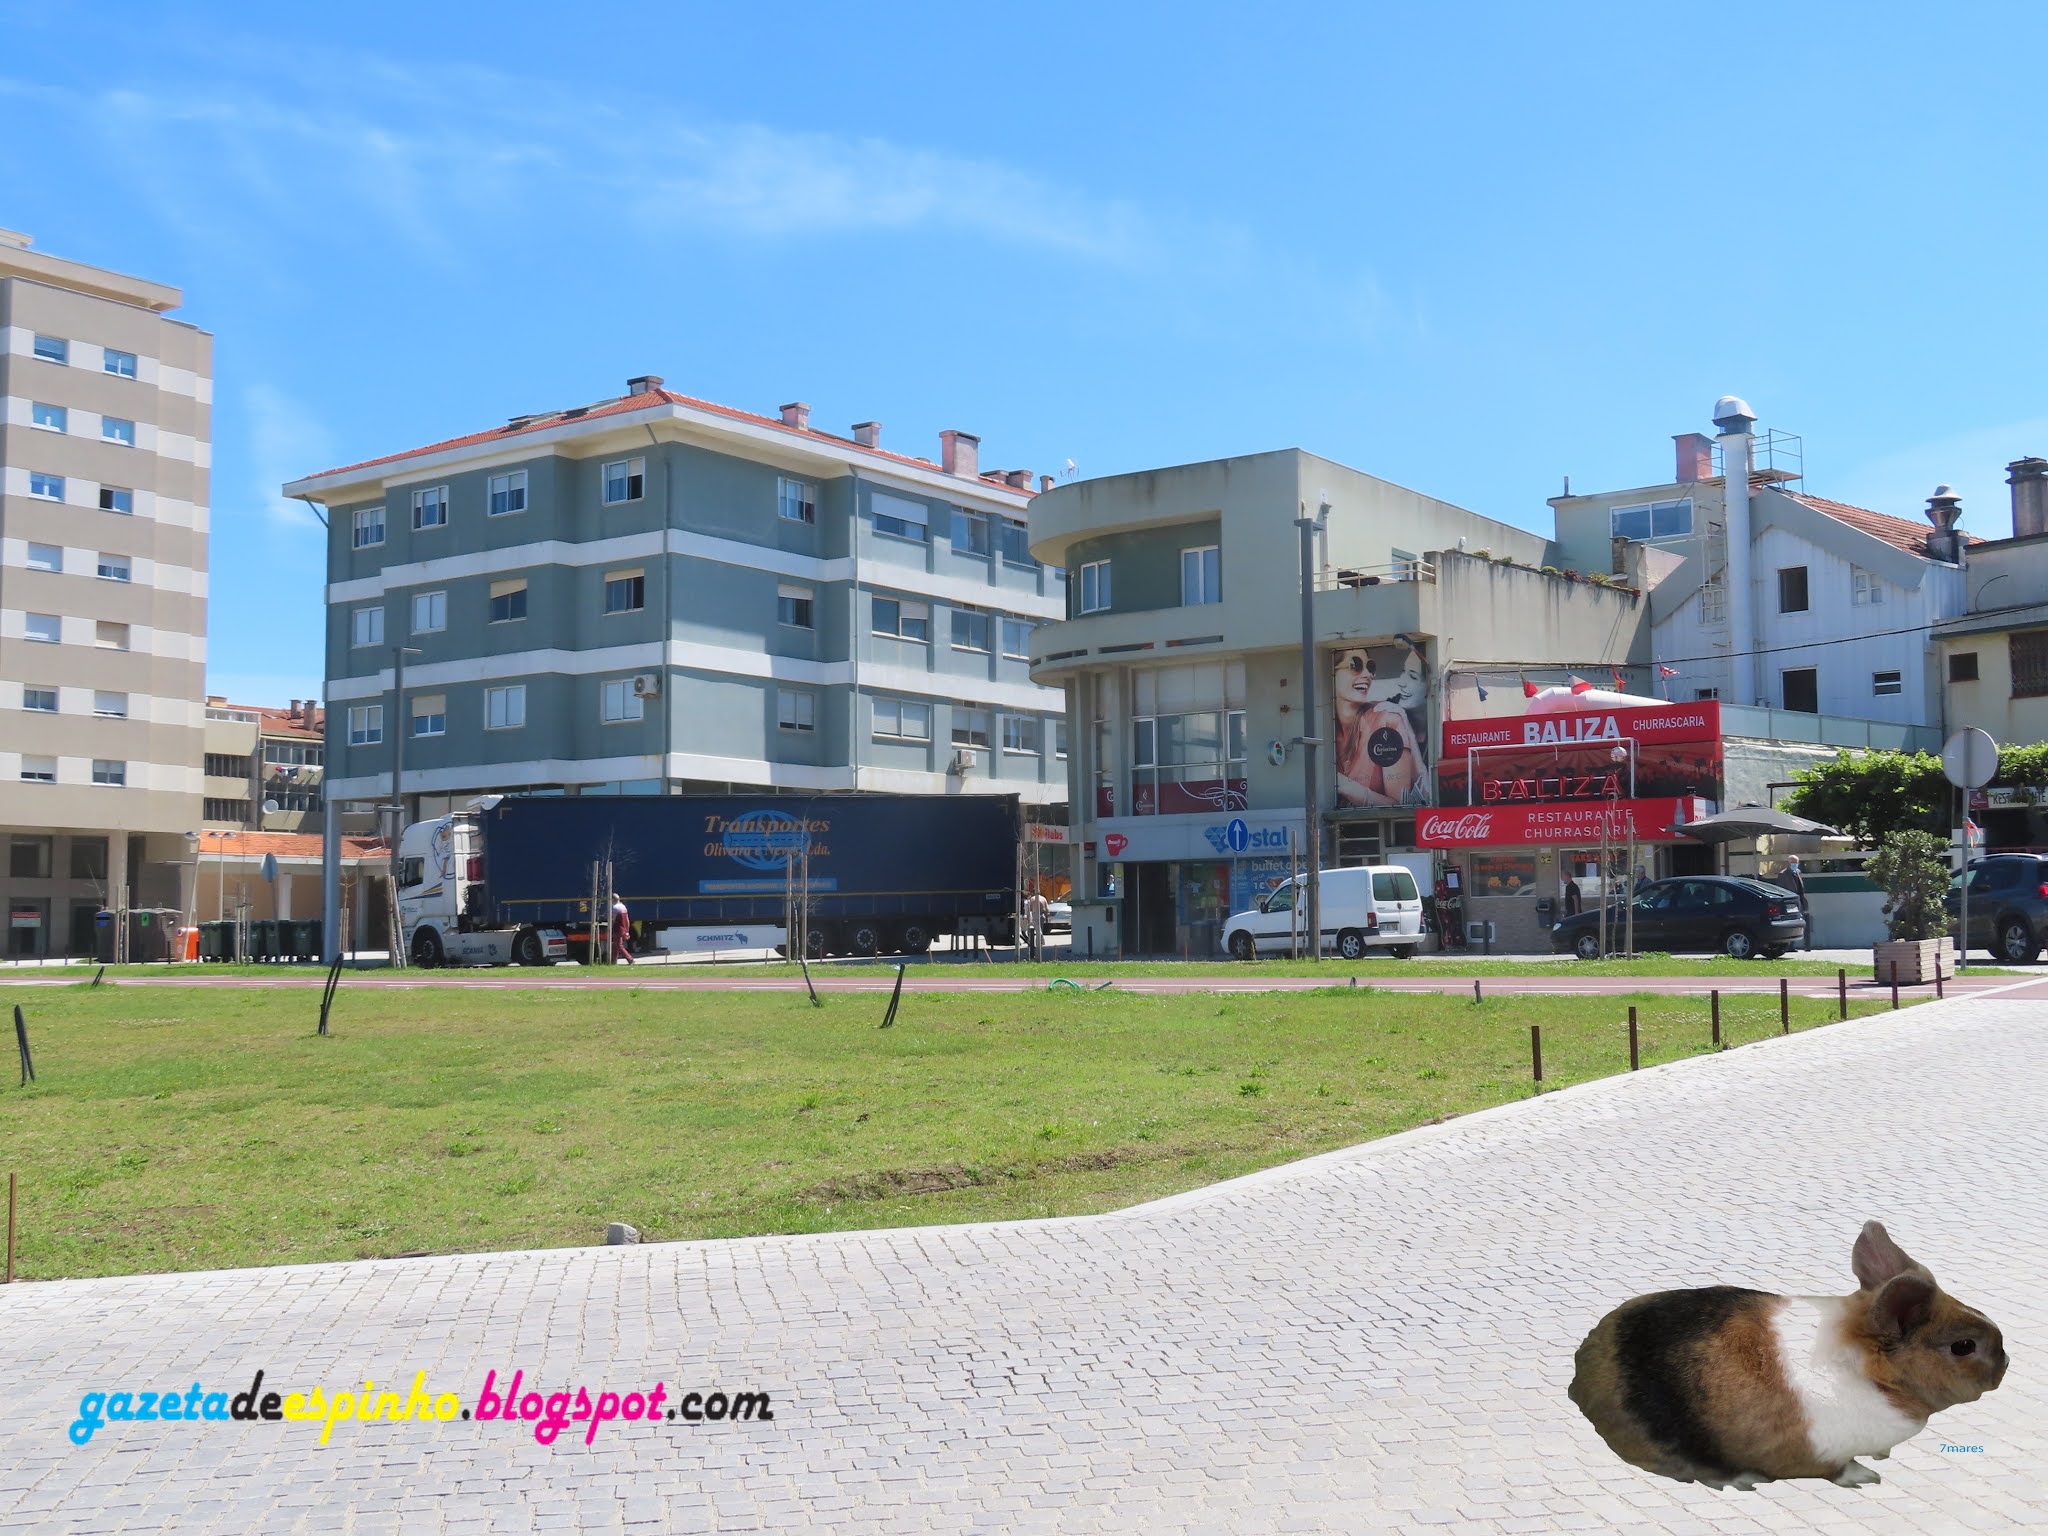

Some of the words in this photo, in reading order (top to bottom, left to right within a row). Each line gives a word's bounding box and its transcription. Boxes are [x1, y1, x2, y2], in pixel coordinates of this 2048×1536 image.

[1523, 715, 1622, 744] BALIZA
[1633, 715, 1706, 731] CHURRASCARIA
[1451, 731, 1511, 744] RESTAURANTE
[1483, 774, 1622, 800] BALIZA
[1528, 808, 1633, 823] RESTAURANTE
[704, 815, 830, 837] Transportes
[1421, 813, 1493, 841] Coca-Cola
[1524, 825, 1638, 839] CHURRASCARIA
[703, 842, 749, 857] Oliveira
[1252, 860, 1284, 872] buffet
